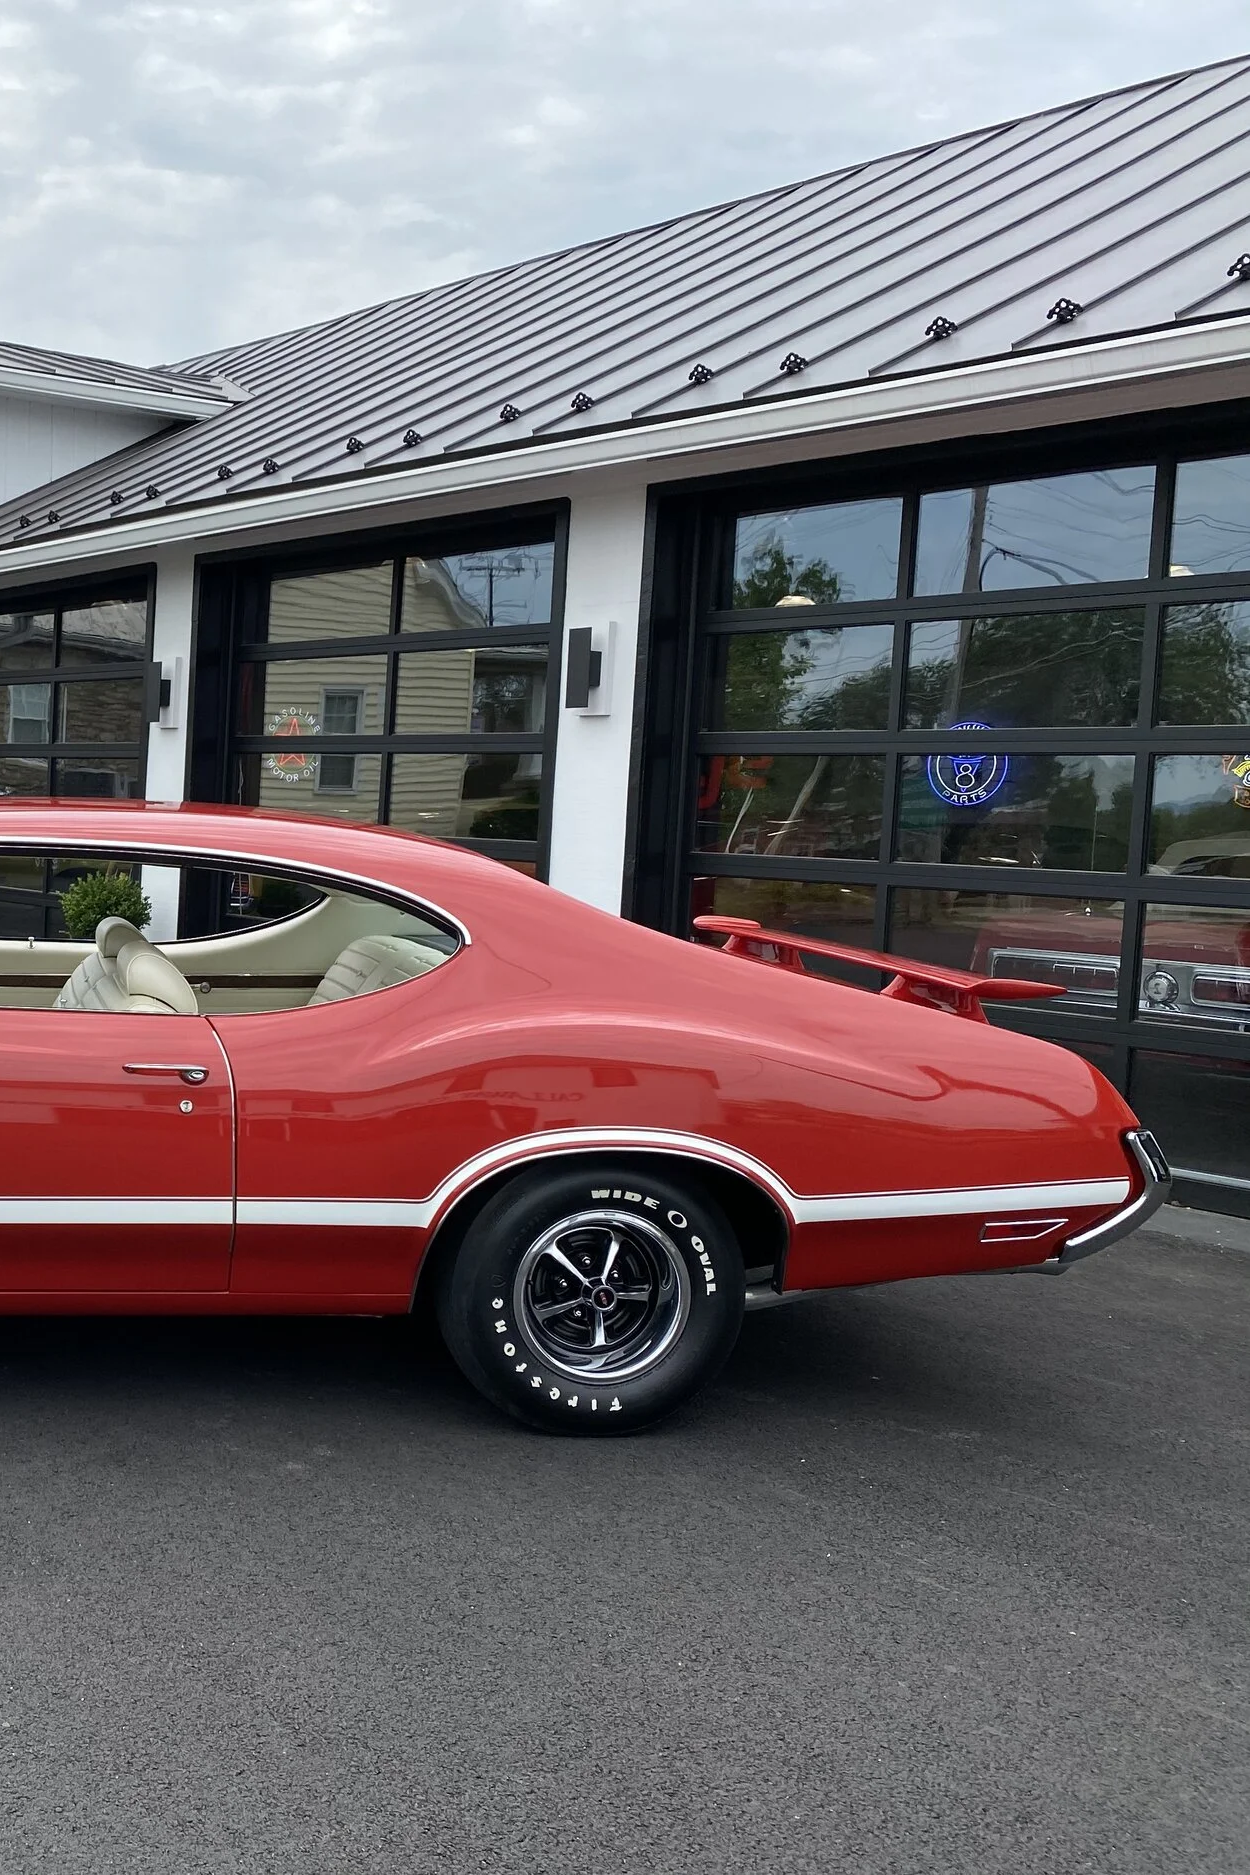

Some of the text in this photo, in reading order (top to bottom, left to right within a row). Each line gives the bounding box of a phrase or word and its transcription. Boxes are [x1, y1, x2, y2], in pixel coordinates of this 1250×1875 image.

[268, 707, 321, 733] GASOLINE
[267, 758, 319, 783] MOTOR OIL
[941, 788, 988, 804] PARTS
[590, 1188, 661, 1210] WIDE
[690, 1235, 717, 1296] OVAL
[491, 1297, 623, 1412] Firestone
